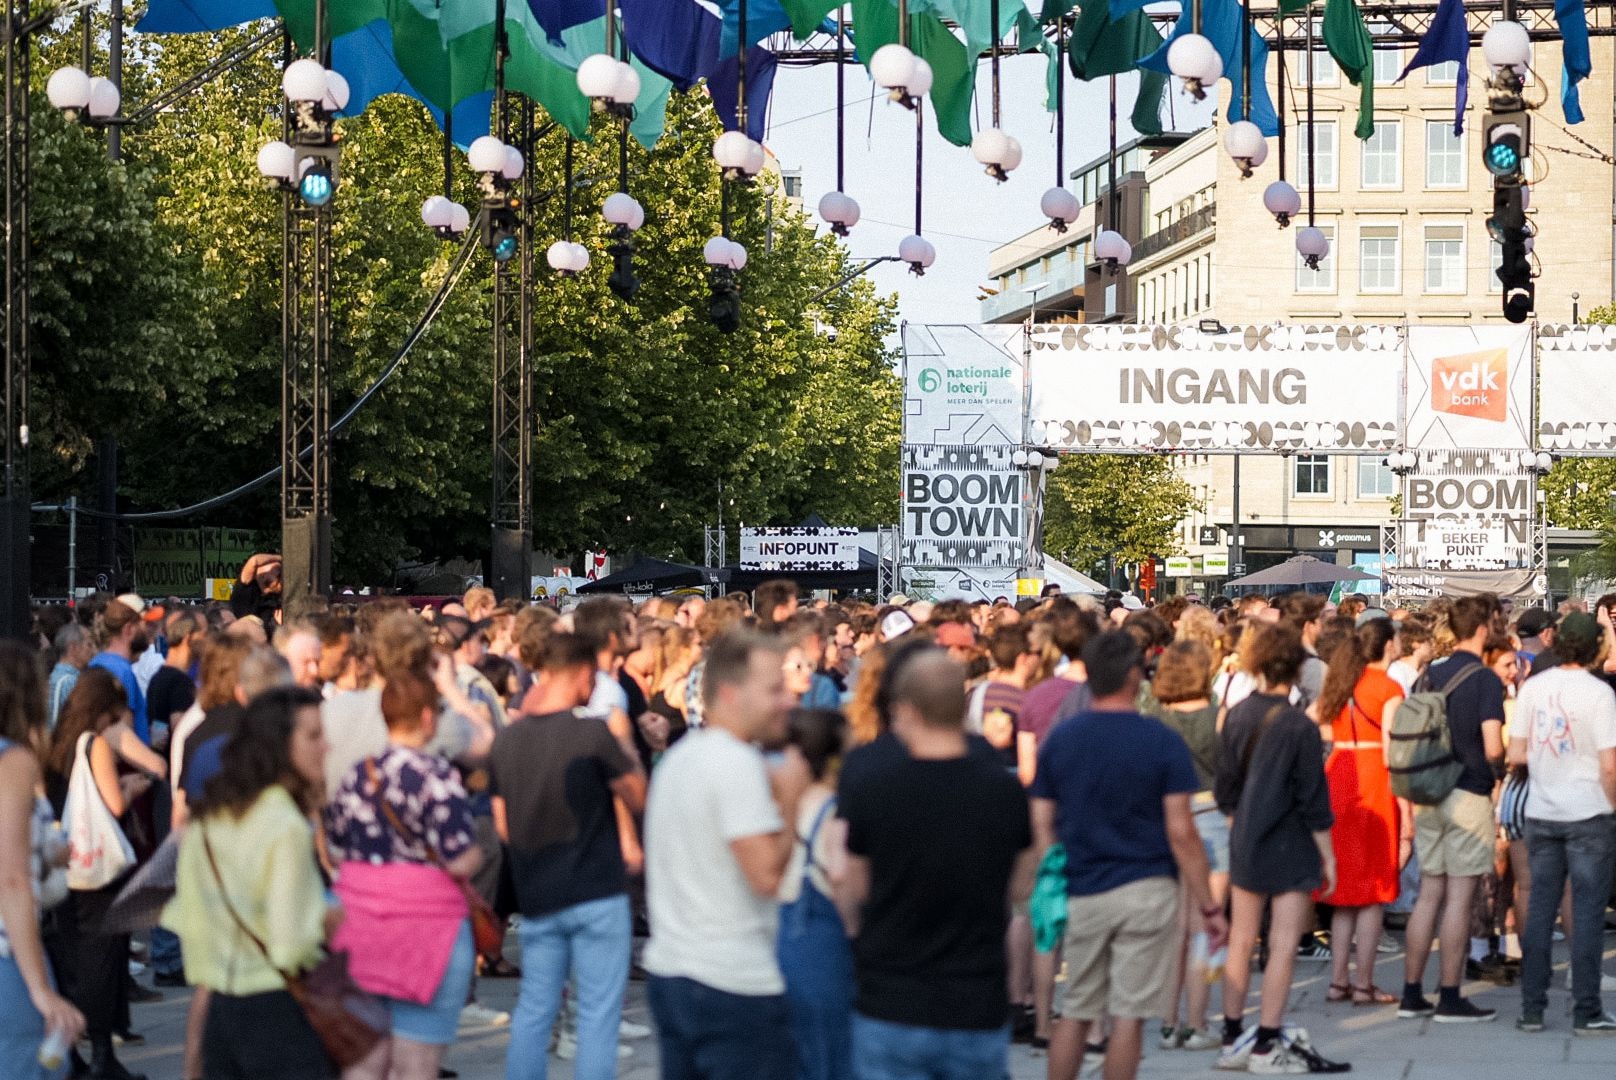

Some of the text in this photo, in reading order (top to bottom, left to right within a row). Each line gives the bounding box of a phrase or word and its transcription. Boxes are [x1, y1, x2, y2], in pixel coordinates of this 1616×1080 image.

[946, 366, 1012, 378] nationale
[1439, 361, 1500, 391] vdk
[947, 381, 988, 397] loterij
[1119, 367, 1307, 405] INGANG
[1451, 392, 1489, 406] bank
[907, 473, 1019, 504] BOOM
[1409, 479, 1527, 510] BOOM
[907, 506, 1019, 537] TOWN
[1409, 512, 1527, 544] TN
[1336, 534, 1372, 543] proximus
[1442, 533, 1489, 544] BEKER
[759, 542, 839, 555] INFOPUNT
[1446, 545, 1485, 556] PUNT
[1386, 573, 1446, 585] Wissel hier
[1399, 585, 1430, 596] beker
[1431, 586, 1443, 596] in
